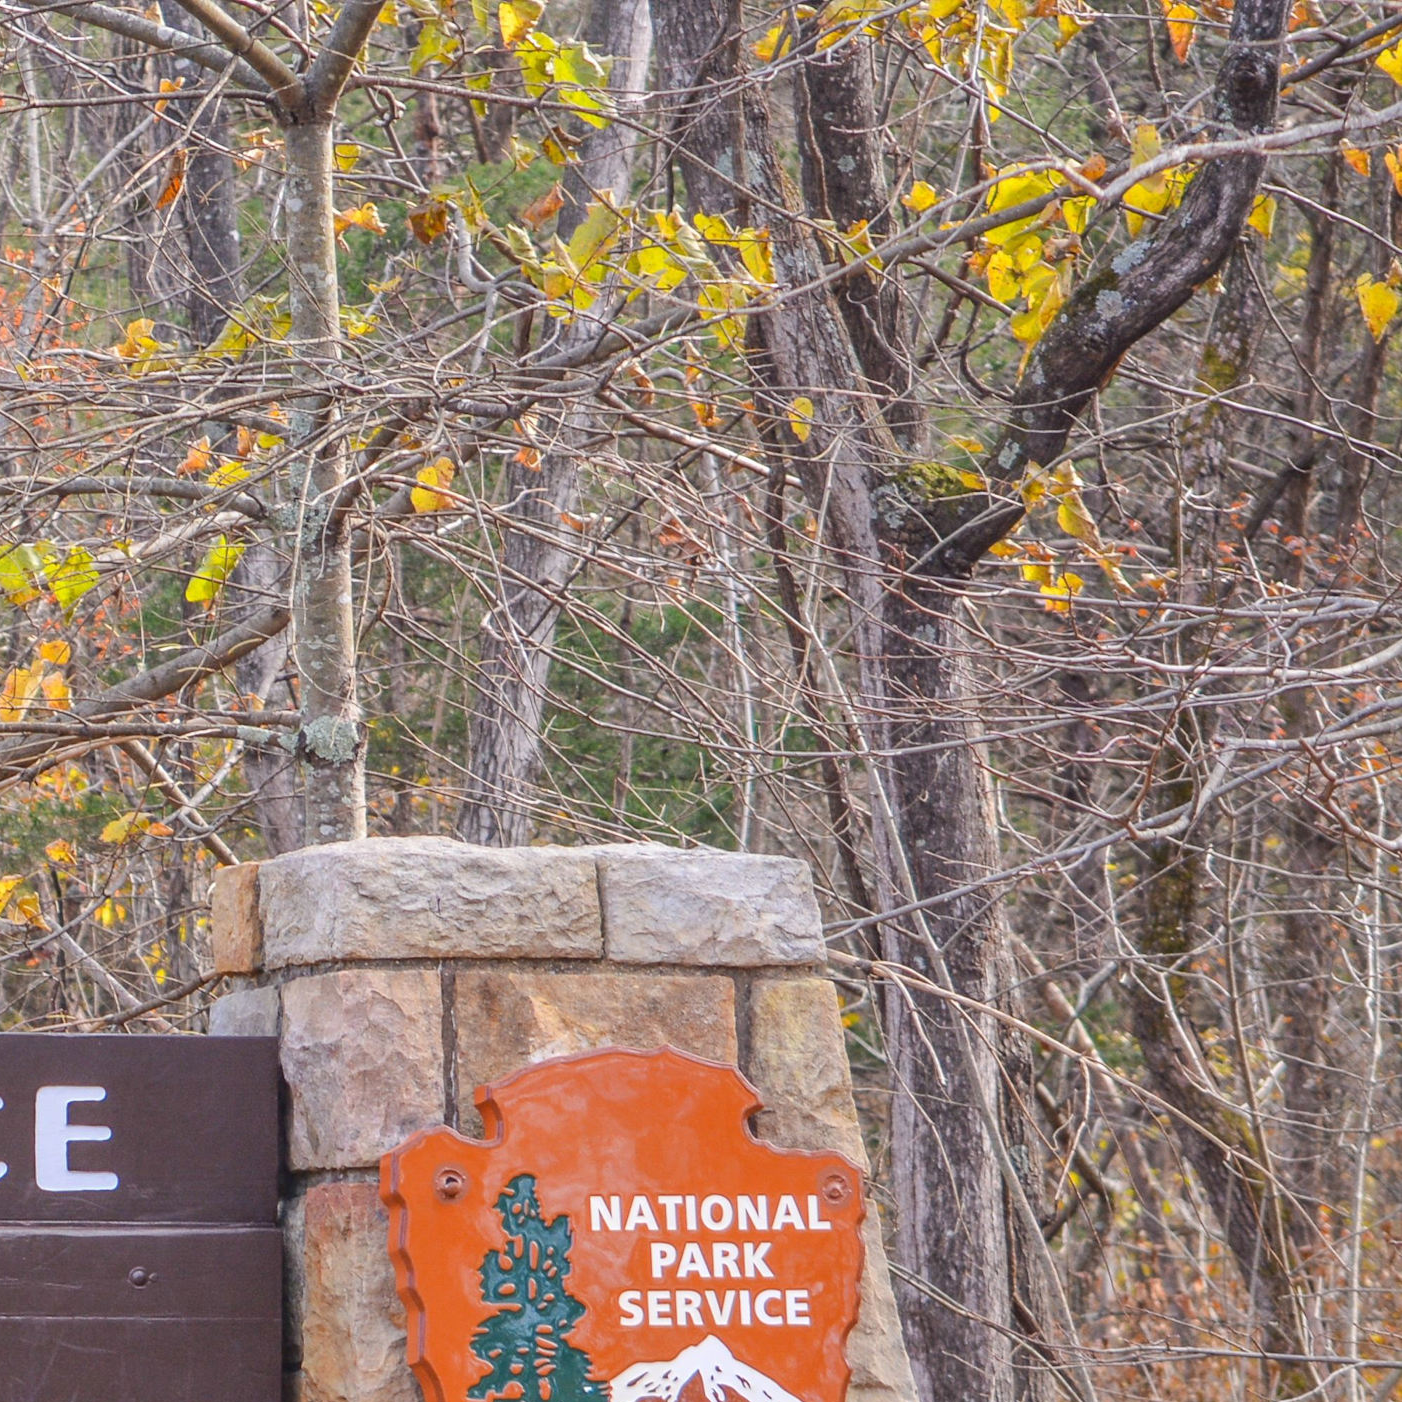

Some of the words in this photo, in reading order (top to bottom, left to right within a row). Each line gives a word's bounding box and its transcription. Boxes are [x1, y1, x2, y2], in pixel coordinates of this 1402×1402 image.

[588, 1194, 832, 1232] NATIONAL
[649, 1242, 775, 1279] PARK
[617, 1289, 811, 1328] SERVICE
